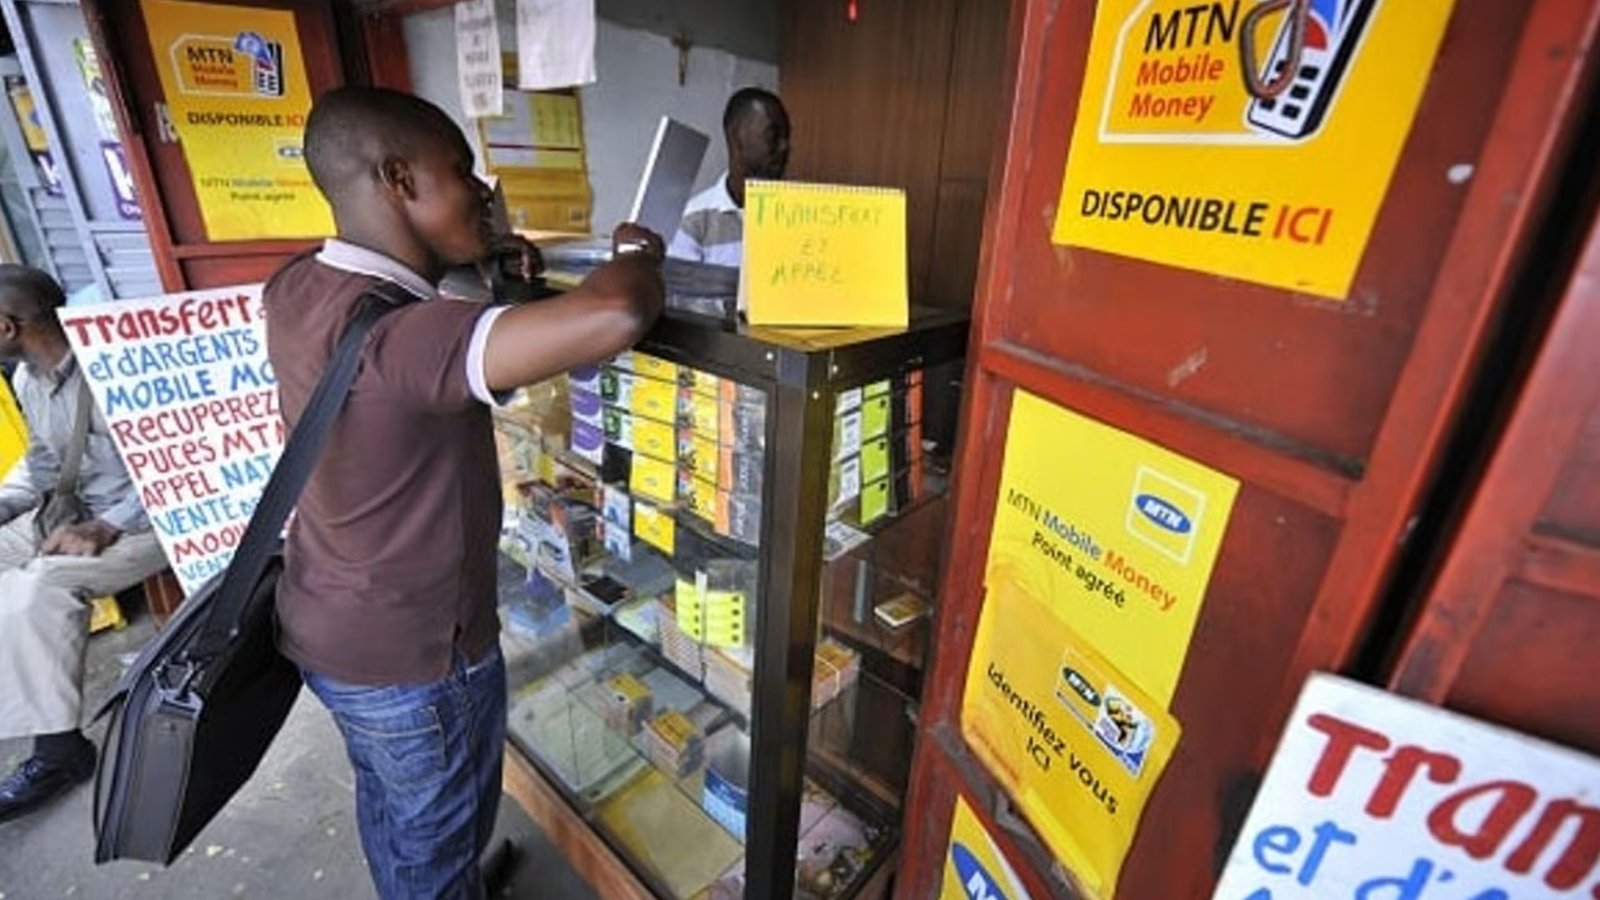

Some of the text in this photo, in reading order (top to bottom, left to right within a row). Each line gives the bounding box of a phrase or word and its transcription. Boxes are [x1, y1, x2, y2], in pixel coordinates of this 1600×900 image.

[1144, 0, 1239, 54] MTN
[186, 46, 234, 63] MTN
[1136, 54, 1224, 87] Mobile
[186, 111, 283, 127] DISPONIBLE
[1128, 94, 1214, 123] Money
[1080, 189, 1334, 246] DISPONIBLE ICI
[65, 294, 251, 347] Transfert
[105, 370, 217, 417] MOBILE
[140, 470, 219, 510] APPEL
[153, 493, 241, 537] VENTE
[1140, 499, 1185, 529] MTN
[1006, 487, 1178, 613] MTN Mobile Money
[1029, 530, 1076, 572] Point
[1068, 751, 1121, 816] vous
[1306, 713, 1600, 892] Tran
[1252, 820, 1358, 887] et
